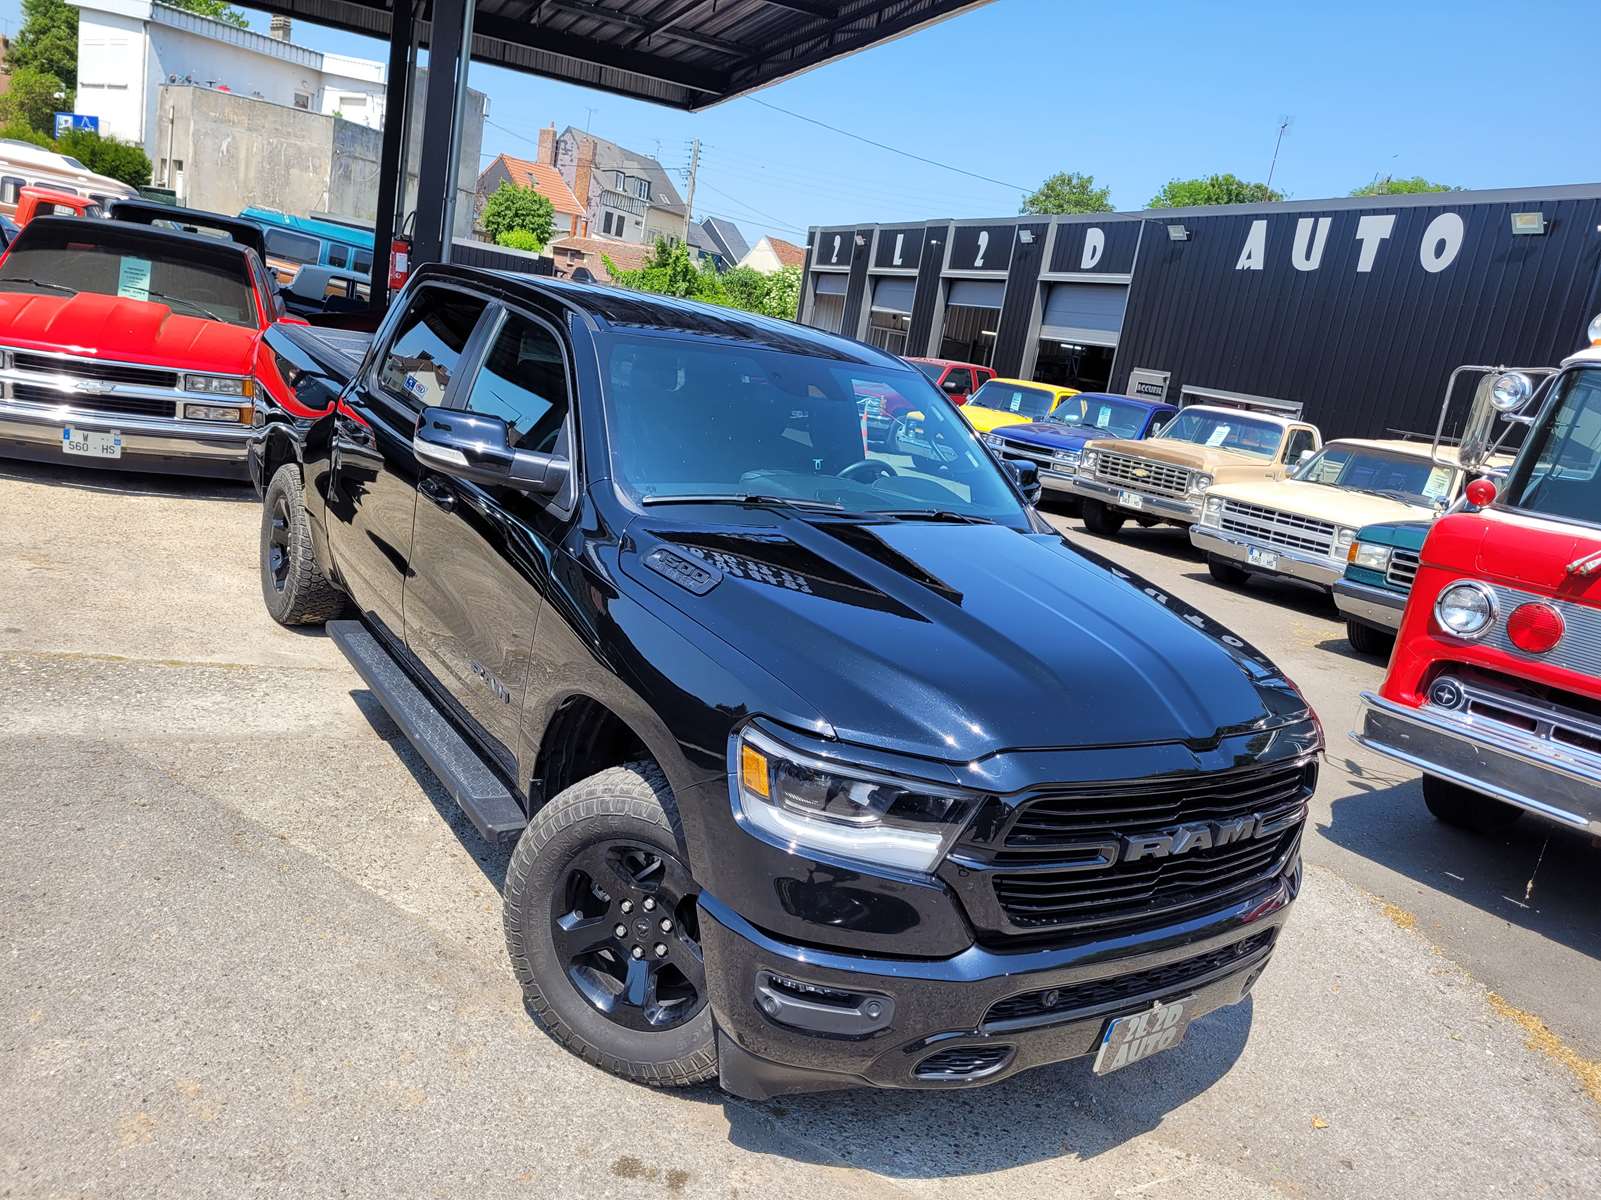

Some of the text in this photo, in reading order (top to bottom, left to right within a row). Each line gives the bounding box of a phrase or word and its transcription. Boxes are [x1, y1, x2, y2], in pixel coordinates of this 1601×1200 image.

[1235, 212, 1464, 273] AUTO
[69, 440, 89, 452] 560
[101, 444, 116, 455] HS
[1123, 814, 1256, 862] RAM
[1110, 1026, 1177, 1070] AUTO
